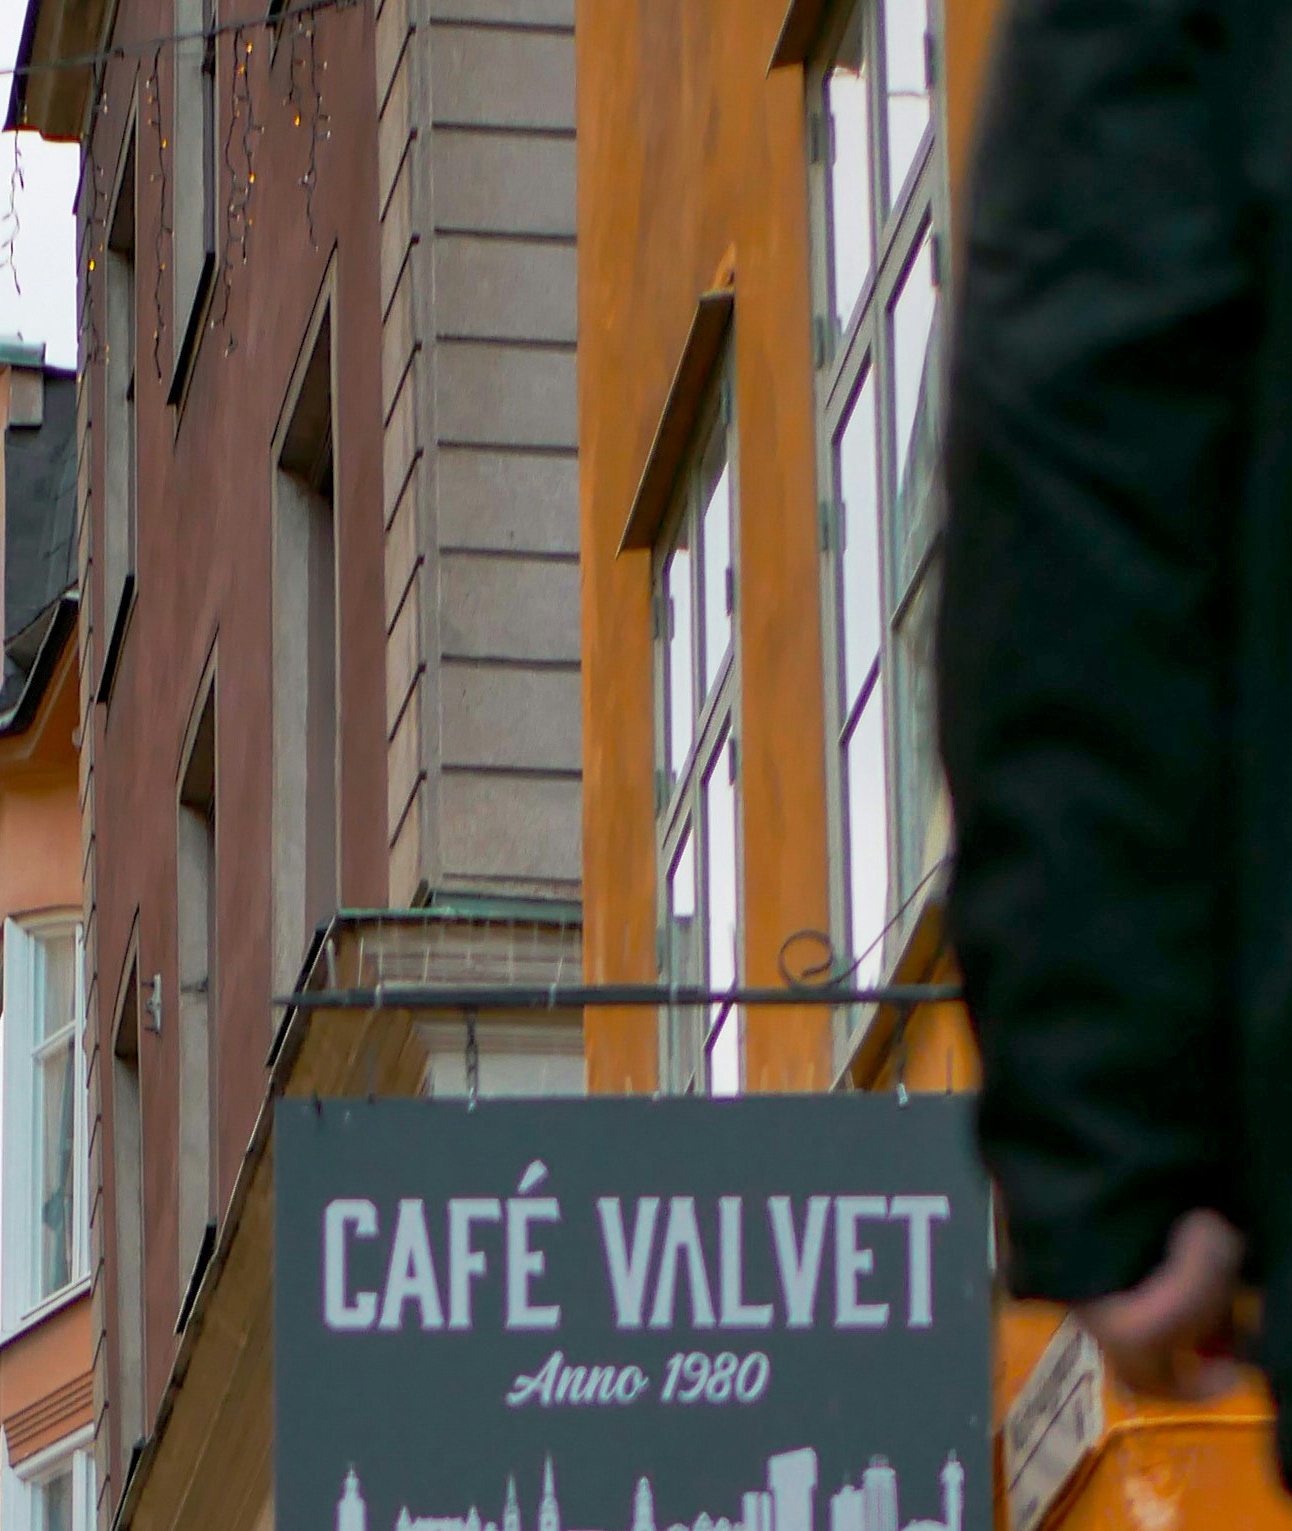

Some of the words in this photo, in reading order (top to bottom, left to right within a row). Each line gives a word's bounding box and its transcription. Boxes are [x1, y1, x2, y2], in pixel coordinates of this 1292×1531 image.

[324, 1158, 561, 1330] CAFÉ
[597, 1195, 950, 1329] VALVET
[508, 1350, 648, 1405] Anno
[660, 1350, 770, 1403] 1980
